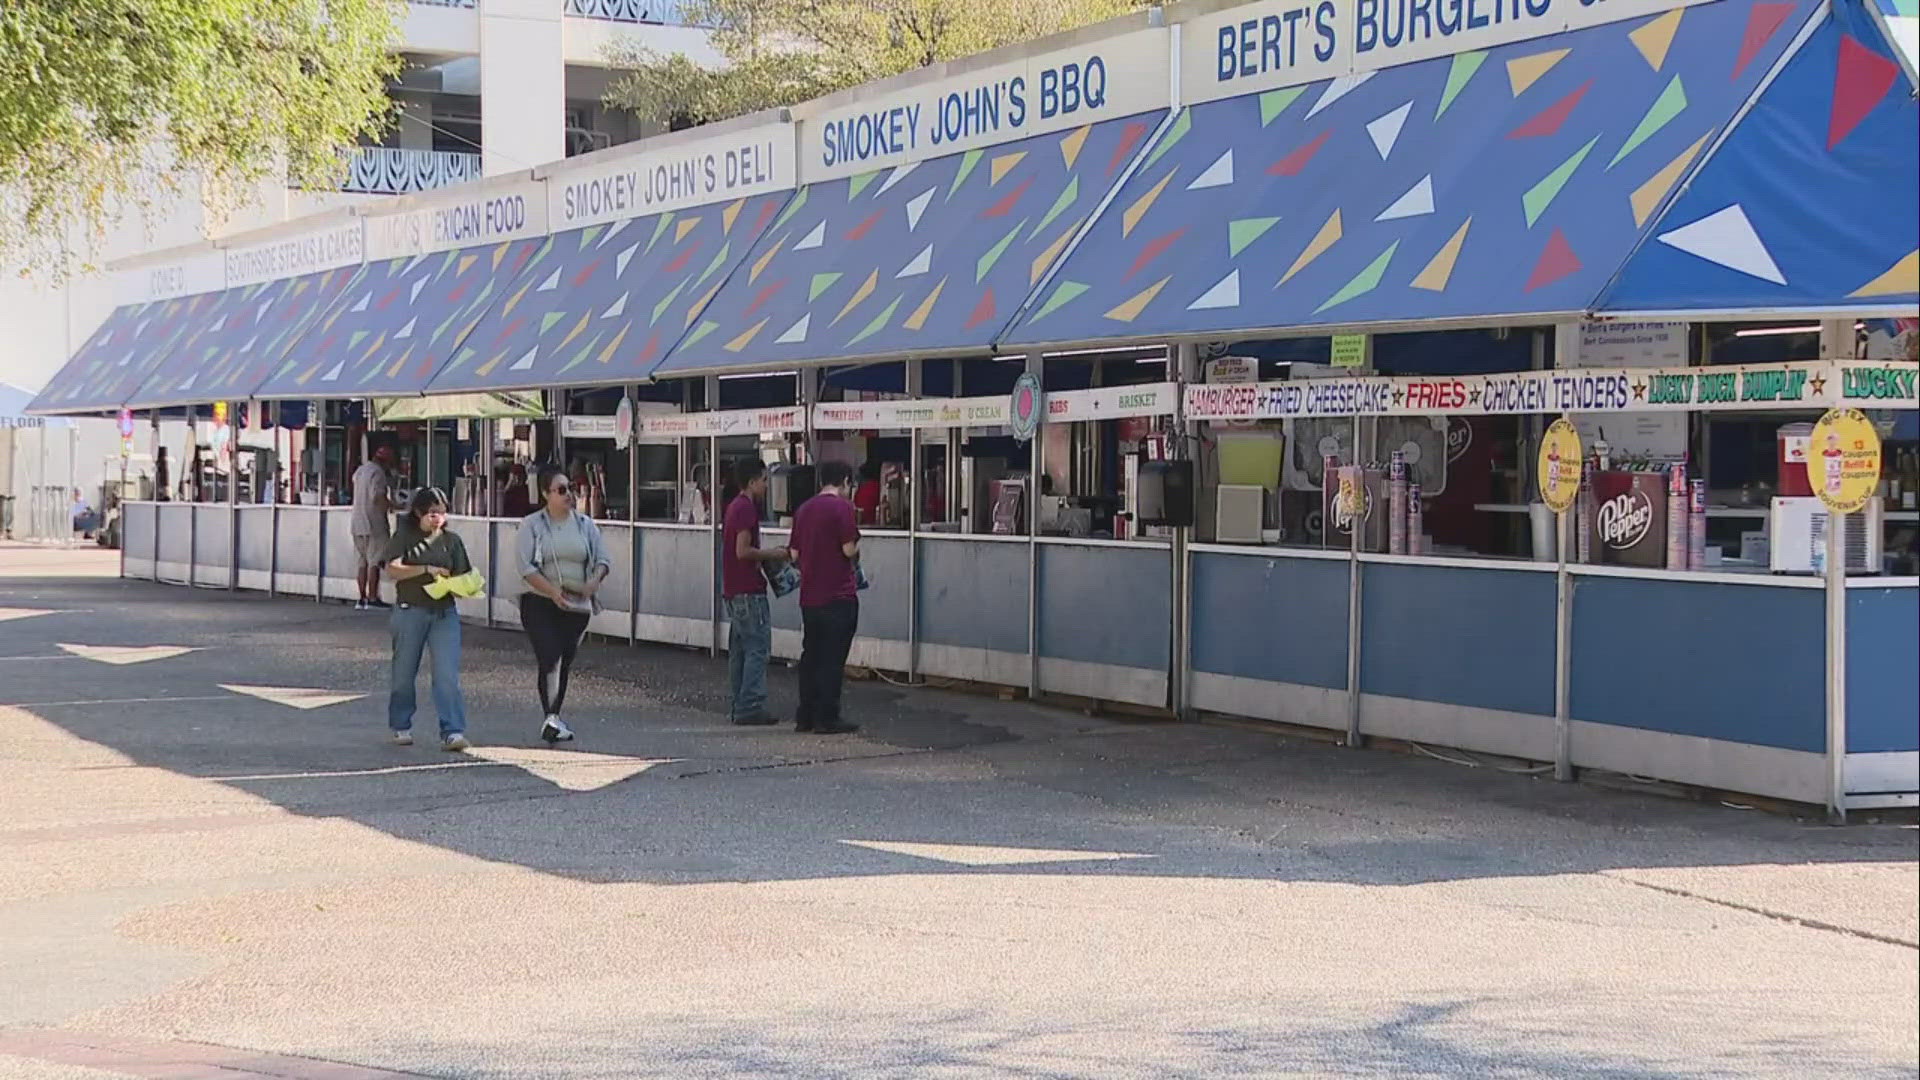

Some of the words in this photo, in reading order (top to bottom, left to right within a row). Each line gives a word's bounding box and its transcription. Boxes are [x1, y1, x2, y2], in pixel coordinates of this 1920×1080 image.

[1217, 1, 1335, 82] BERT'S
[823, 103, 921, 167] SMOKEY
[931, 76, 1026, 145] JOHN'S
[1040, 55, 1107, 120] BBQ
[564, 171, 636, 220] SMOKEY
[645, 154, 716, 204] JOHN'S
[725, 142, 773, 188] DELI
[485, 195, 526, 235] FOOD
[228, 247, 276, 281] SOUTHSIDE
[278, 237, 316, 272] STEAKS
[319, 237, 325, 263] &
[327, 226, 361, 261] CAKES
[1187, 387, 1257, 416] HAMBURGER
[1267, 386, 1303, 415] FRIED
[1305, 383, 1390, 415] CHEESECAKE
[1406, 380, 1466, 409] FRIES
[1482, 376, 1547, 412] CHICKEN
[1552, 375, 1628, 410] TENDERS
[1647, 374, 1694, 404] LUCKY
[1696, 371, 1737, 403] DUCK
[1841, 367, 1919, 400] LUCKY
[1049, 399, 1069, 414] RIBS
[1118, 393, 1157, 409] BRISKET
[0, 415, 46, 429] FLOOR
[1822, 409, 1840, 426] BIG
[1845, 408, 1865, 422] TEX
[1842, 450, 1877, 459] Coupons
[1854, 439, 1865, 450] 13
[1840, 471, 1876, 480] Coupons
[1843, 460, 1866, 469] Refill
[1616, 493, 1636, 518] Dr
[1817, 488, 1857, 511] SOUVENIR
[1857, 486, 1872, 504] CUP
[1603, 499, 1649, 543] Pepper
